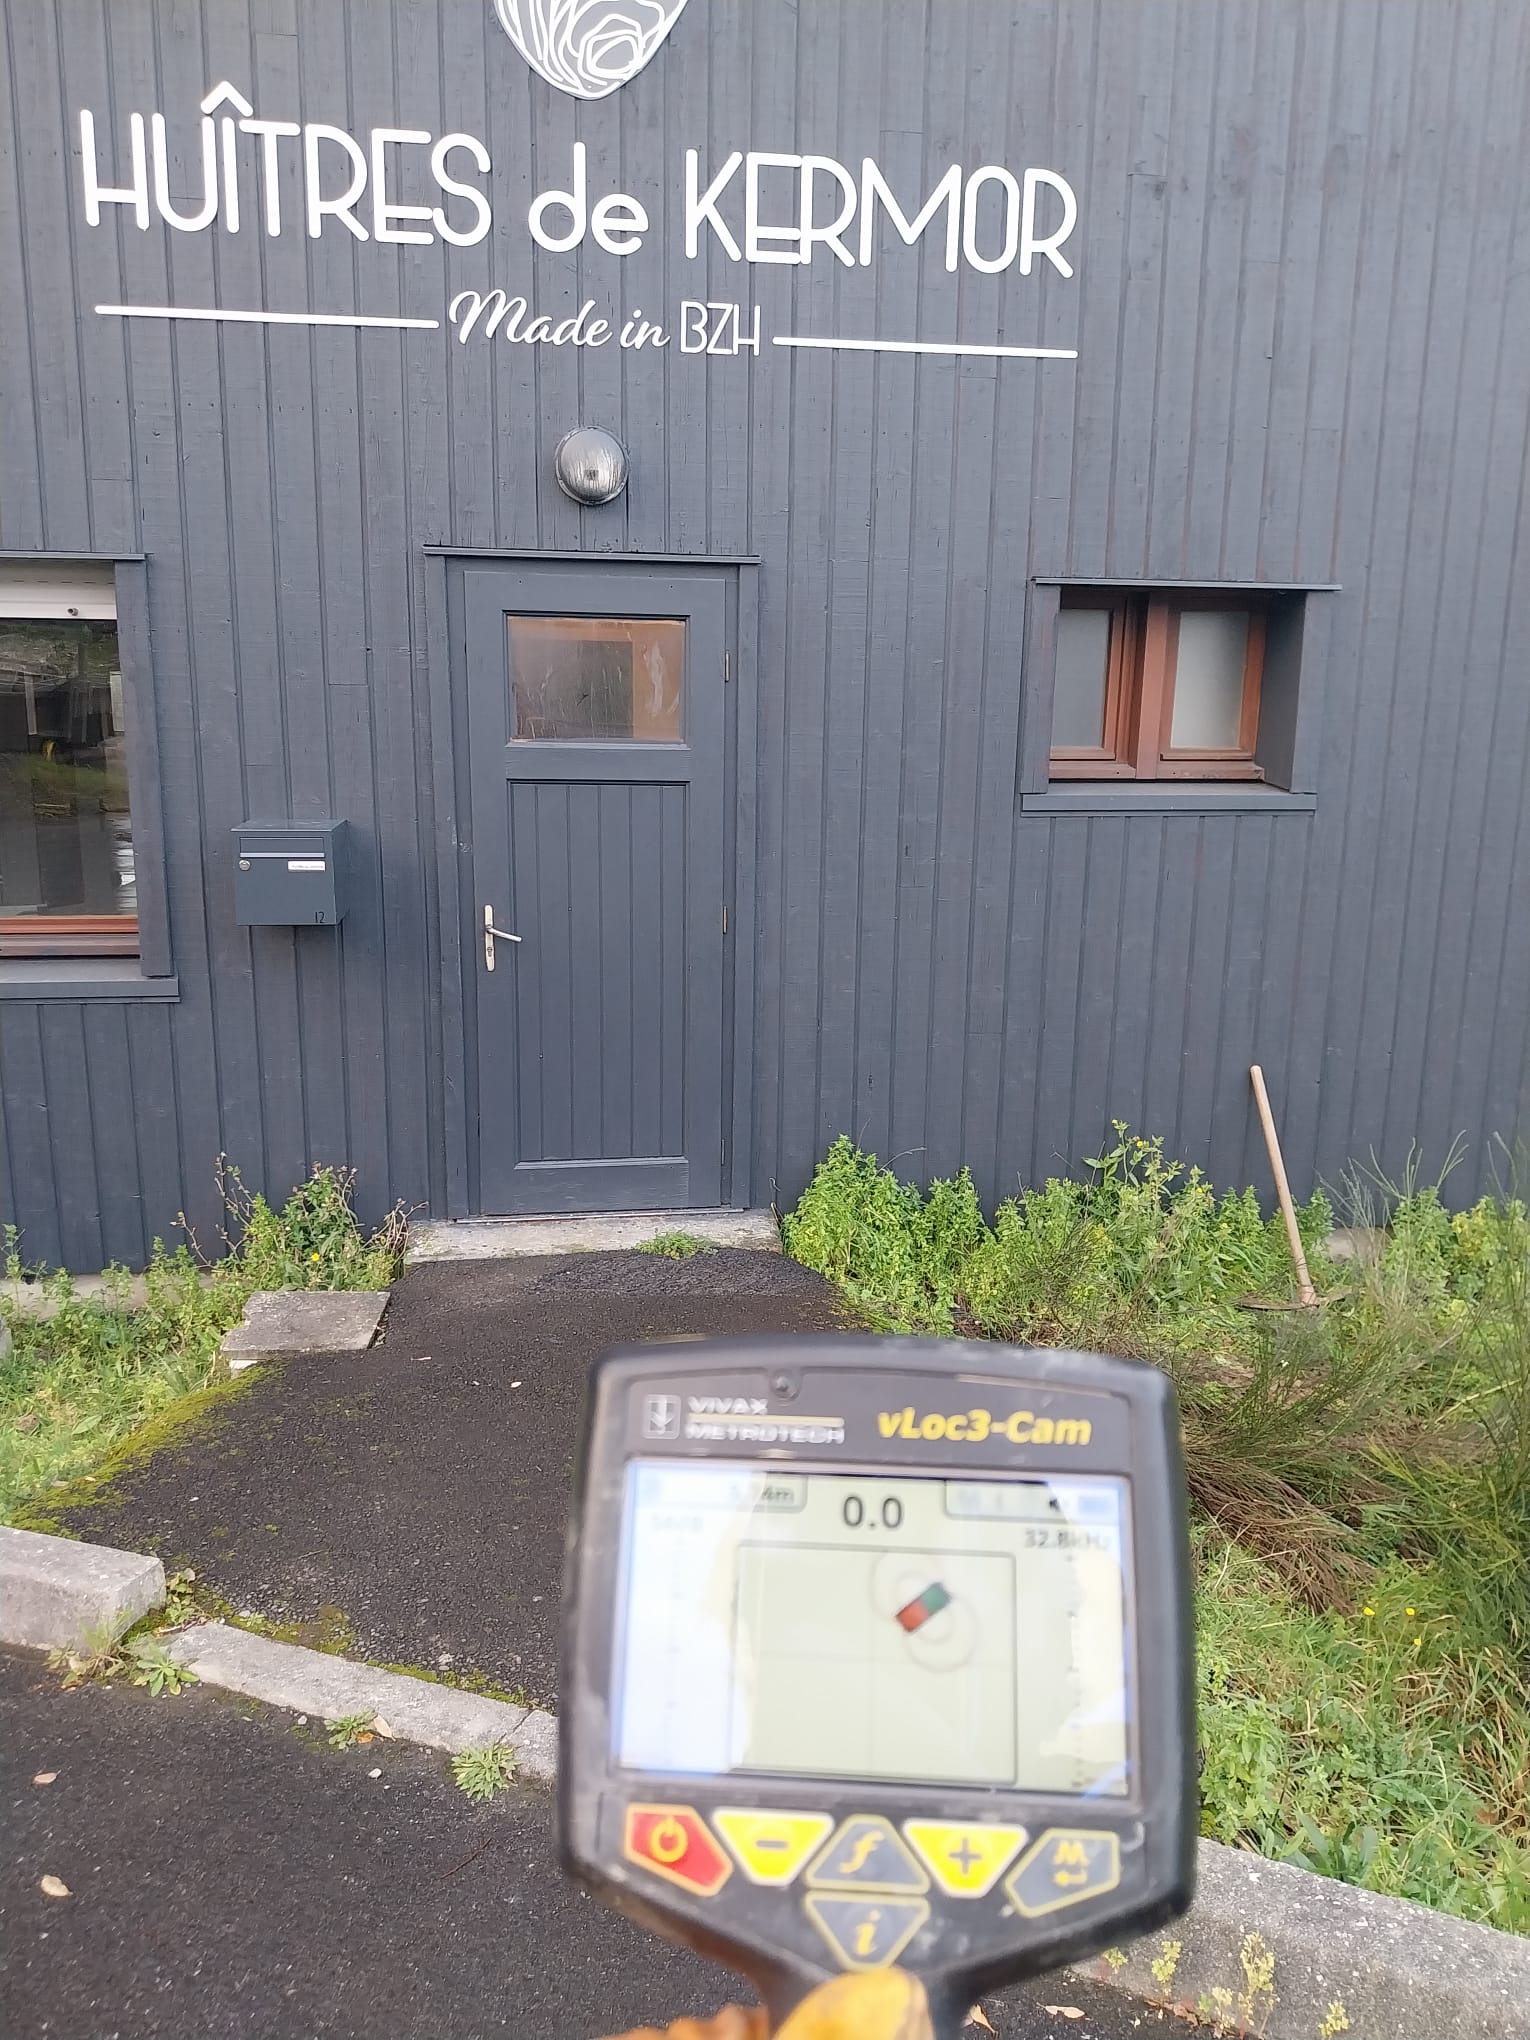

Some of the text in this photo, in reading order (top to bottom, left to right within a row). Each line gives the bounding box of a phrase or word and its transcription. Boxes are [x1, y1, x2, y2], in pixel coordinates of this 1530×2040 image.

[80, 81, 1077, 279] HUÎTRES de KERMOR
[449, 290, 760, 356] Made in BZH
[315, 911, 328, 924] 12
[688, 1395, 768, 1415] VIVAX
[878, 1406, 1092, 1445] vLoc3-Cam
[842, 1495, 904, 1529] 0.0
